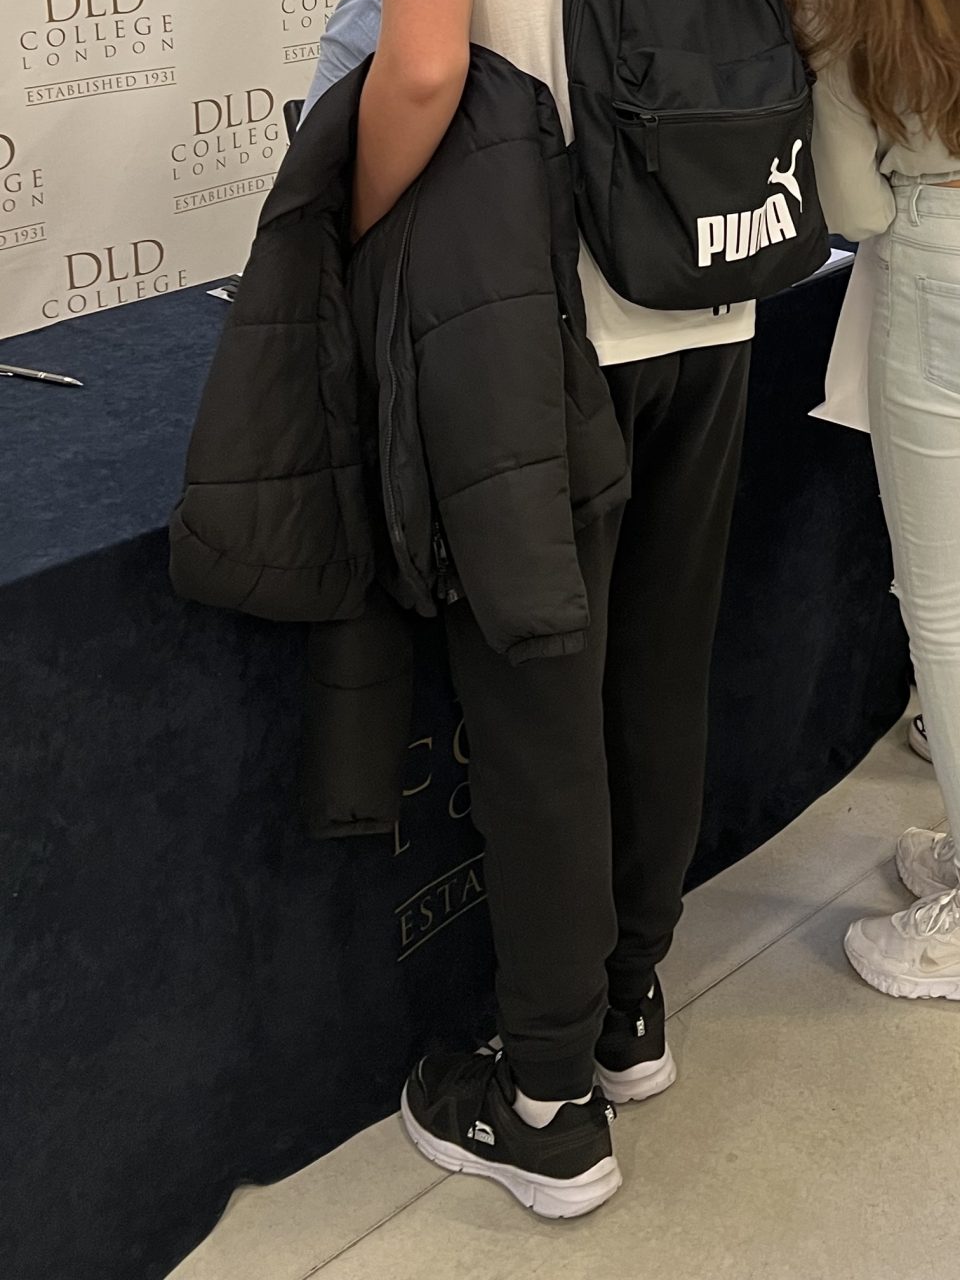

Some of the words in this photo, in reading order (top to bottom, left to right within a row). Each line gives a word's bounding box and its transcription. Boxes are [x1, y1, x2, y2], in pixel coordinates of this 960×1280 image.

[20, 14, 173, 51] COLLEGE
[22, 38, 173, 70] LONDON
[27, 75, 136, 103] ESTABLISHED
[145, 71, 174, 84] 1931
[192, 88, 274, 136] DLD
[171, 123, 278, 162] COLLEG
[173, 146, 273, 180] LONDO
[176, 179, 265, 210] ESTABLISHED
[14, 226, 44, 243] 1931
[697, 193, 797, 267] PUMA
[64, 239, 164, 291] DLD
[42, 269, 186, 319] COLLEGE
